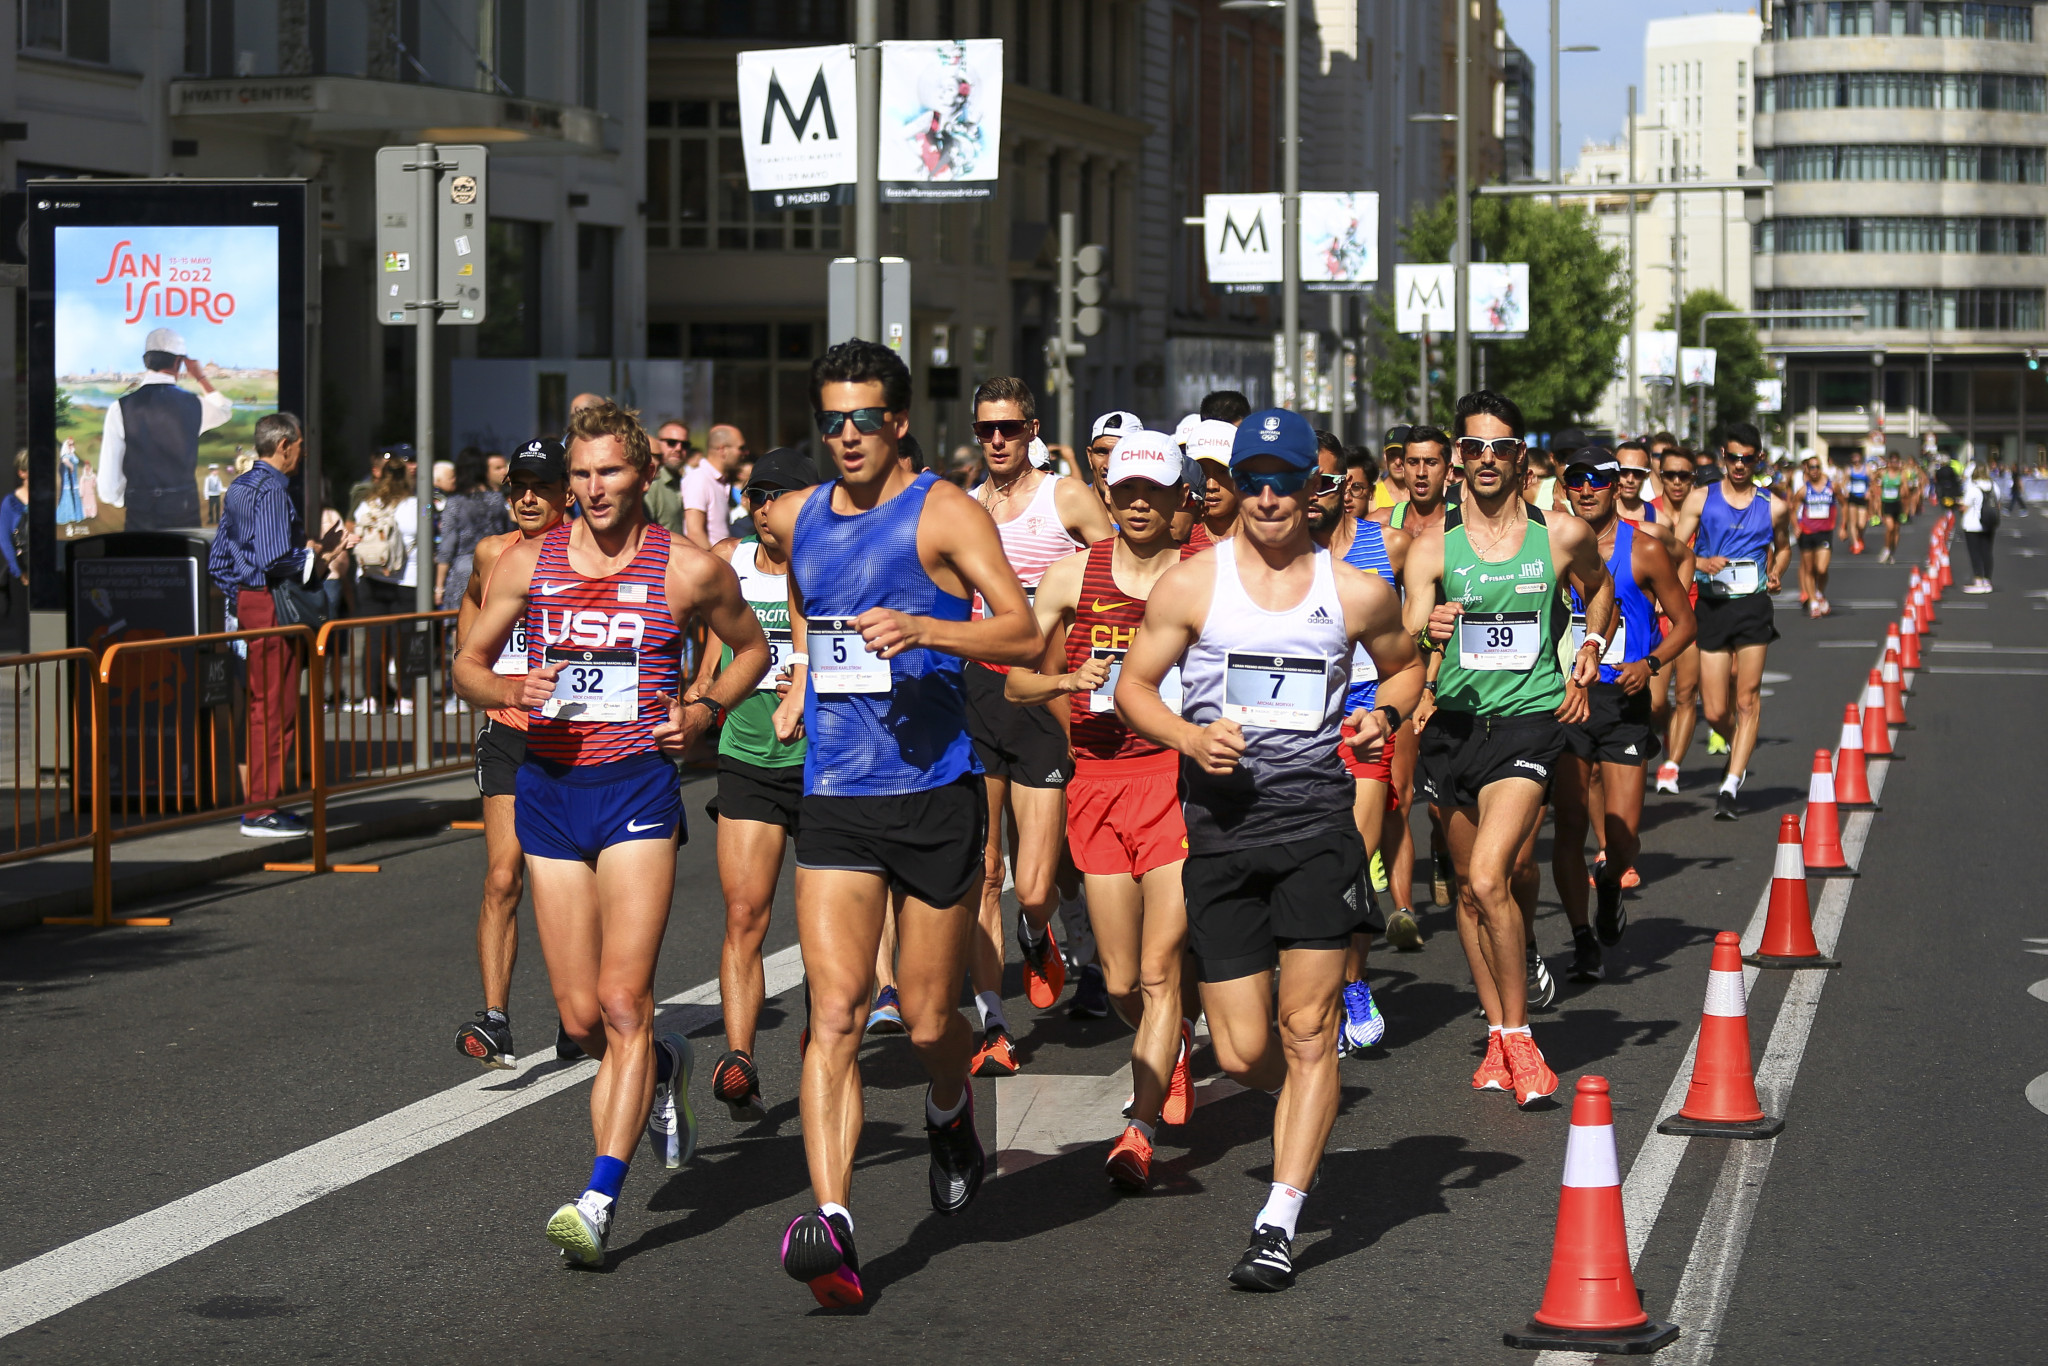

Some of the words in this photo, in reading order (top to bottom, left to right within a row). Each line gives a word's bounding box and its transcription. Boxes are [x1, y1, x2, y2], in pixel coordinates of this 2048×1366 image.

[182, 88, 232, 103] HYATT
[239, 85, 312, 102] CENTRIC
[787, 191, 831, 205] MADRID
[96, 240, 161, 284] SAN
[190, 257, 212, 265] MAYO
[169, 267, 212, 282] 2022
[125, 281, 236, 324] ISIDRO
[1197, 438, 1231, 448] CHINA
[1121, 450, 1165, 463] CHINA
[1489, 574, 1515, 582] FISALDE
[1731, 570, 1737, 581] 1
[541, 608, 646, 649] USA
[1307, 617, 1334, 625] adidas
[509, 633, 527, 653] 19
[1486, 627, 1514, 648] 39
[833, 637, 848, 664] 5
[572, 668, 604, 694] 32
[1269, 673, 1286, 699] 7
[1514, 760, 1547, 776] JCastillo
